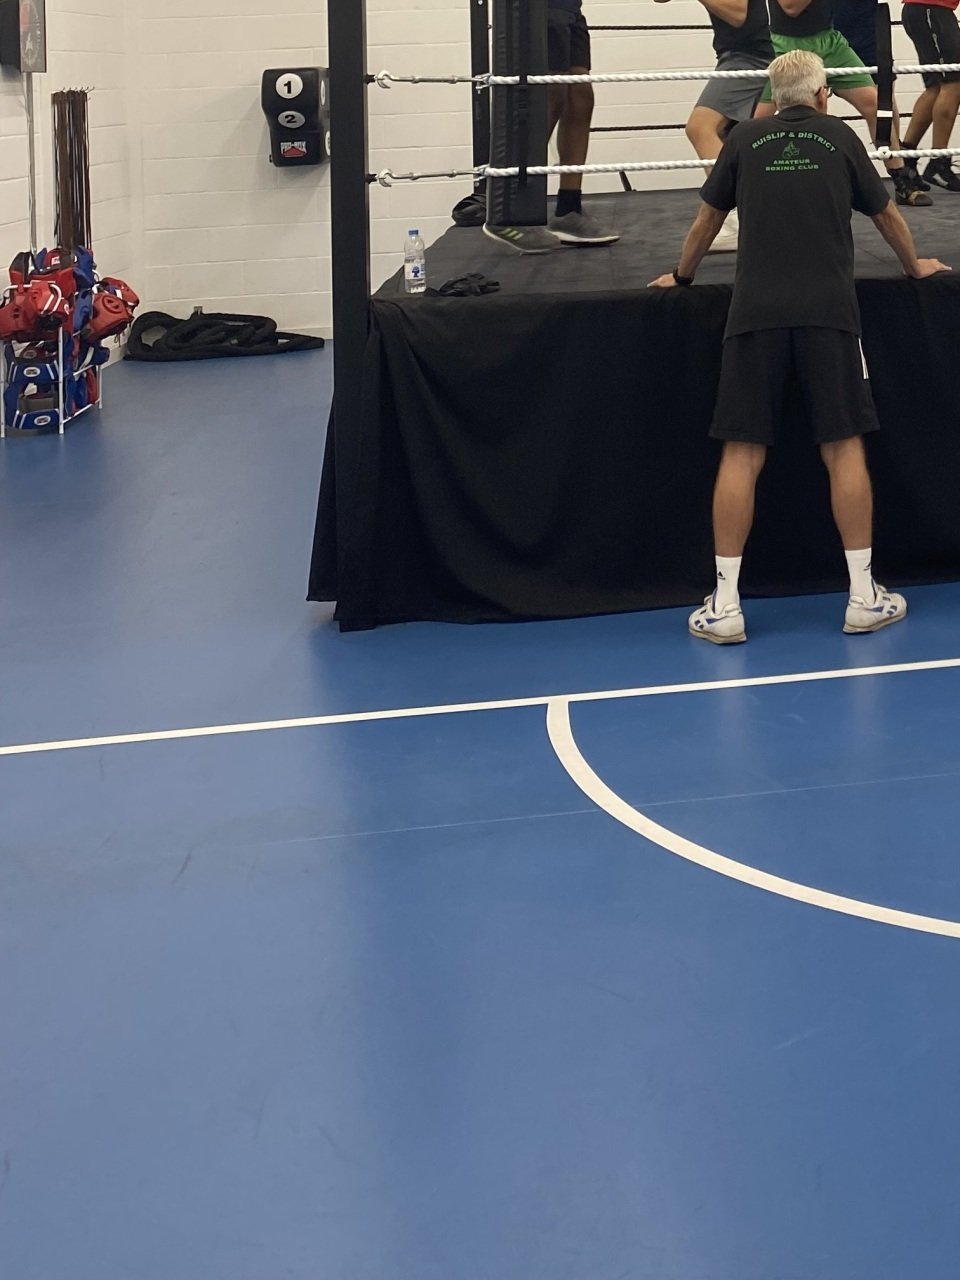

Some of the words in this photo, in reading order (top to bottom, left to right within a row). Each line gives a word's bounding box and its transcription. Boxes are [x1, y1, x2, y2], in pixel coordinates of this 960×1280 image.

[284, 81, 292, 94] 1
[284, 115, 297, 123] 2
[752, 131, 786, 149] RUISLIP
[798, 132, 836, 152] DISTRICT
